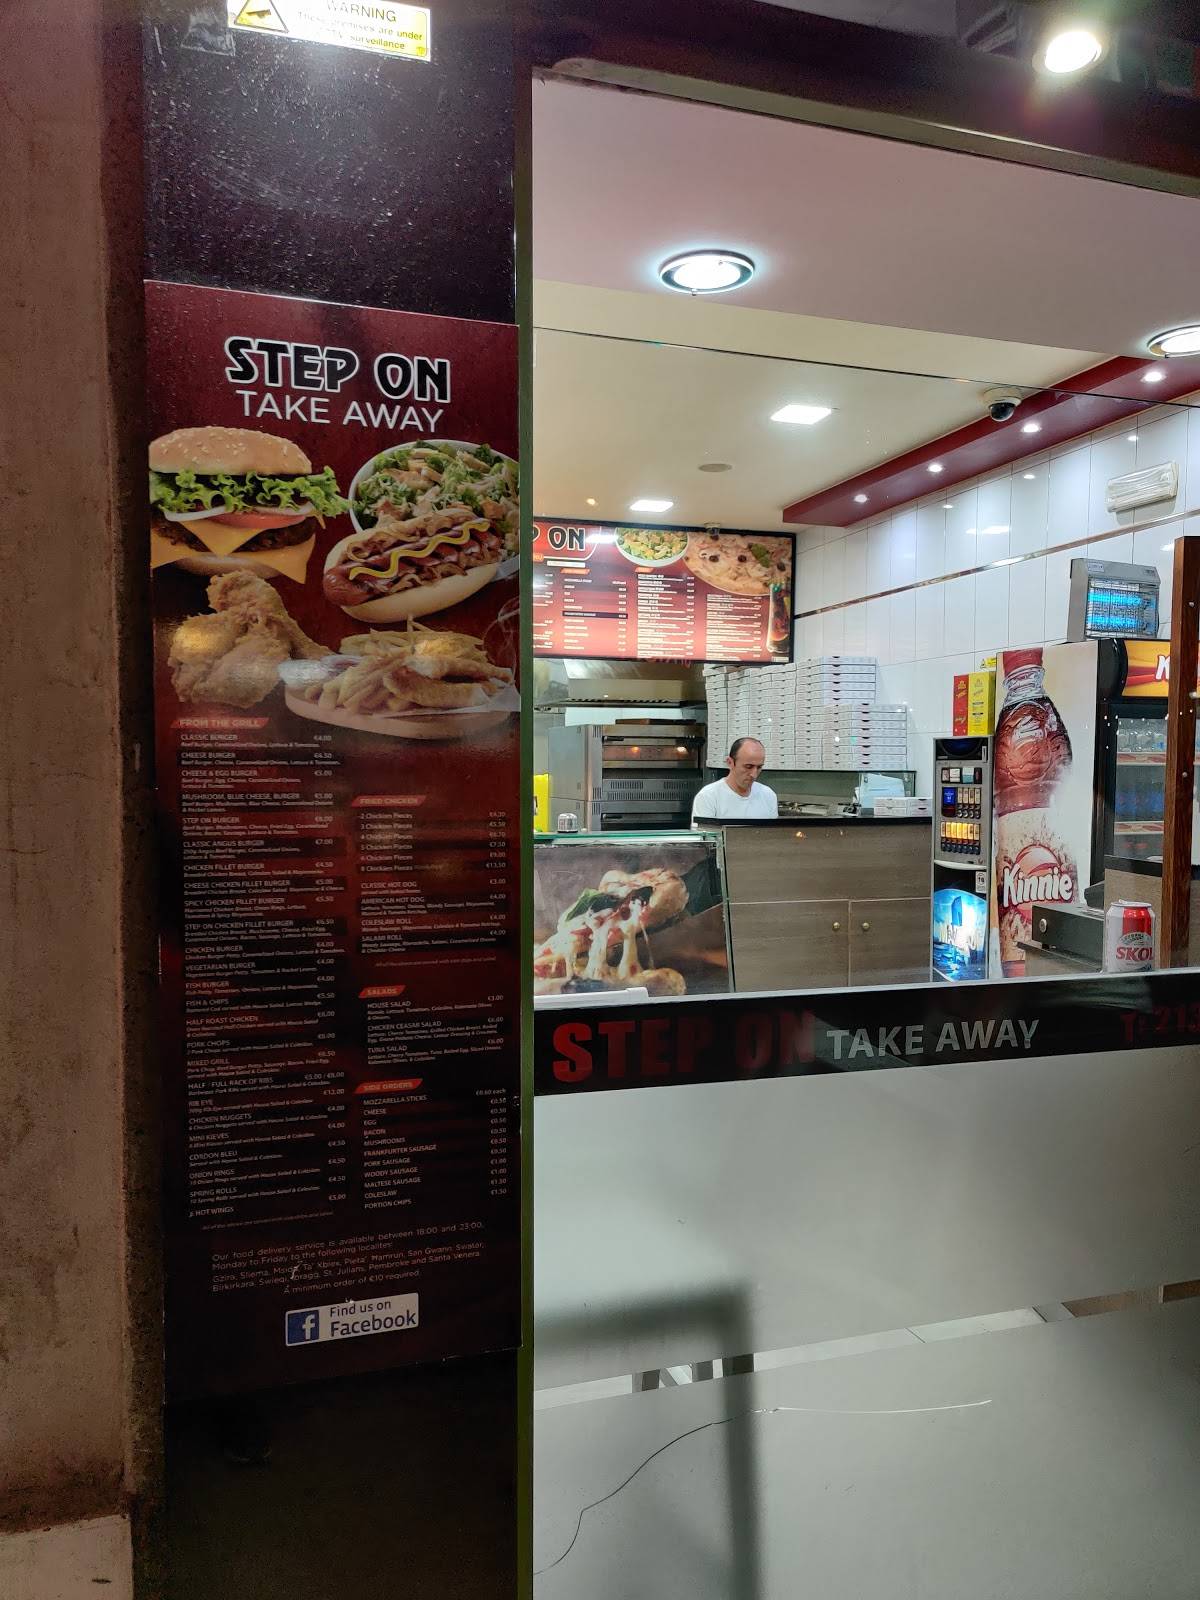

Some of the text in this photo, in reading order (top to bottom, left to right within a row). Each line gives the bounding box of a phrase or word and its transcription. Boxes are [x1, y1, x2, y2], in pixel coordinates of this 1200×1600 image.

[326, 0, 397, 22] WARNING
[397, 30, 422, 41] under
[350, 35, 405, 50] surveillance
[224, 336, 450, 403] STEP ON
[235, 389, 444, 433] TAKE AWAY
[548, 525, 586, 551] ON
[264, 879, 290, 887] BURGER
[1003, 863, 1073, 908] Kinnie
[209, 998, 229, 1006] CHIPS
[186, 1018, 203, 1026] HALF
[229, 1015, 259, 1023] CHICKEN
[367, 1024, 394, 1032] CHICKEN
[552, 1016, 713, 1083] STEP
[735, 1009, 816, 1070] ON
[826, 1024, 924, 1060] TAKE
[936, 1019, 1040, 1053] AWAY
[188, 1081, 205, 1089] HALF
[211, 1080, 229, 1088] FULL
[363, 1097, 406, 1105] MOZZARELLA
[188, 1113, 252, 1125] CHICKEN NUGGETS
[188, 1150, 238, 1161] CORDON BLEU
[363, 1144, 437, 1156] FRANKFURTER SAUSAGE
[382, 1157, 410, 1166] SAUSAGE
[188, 1168, 235, 1179] ONION RINGS
[363, 1167, 418, 1178] WOODY SAUSAGE
[363, 1177, 421, 1188] MALTESE SAUSAGE
[189, 1187, 237, 1198] SPRING ROLLS
[364, 1190, 397, 1199] COLESLAW
[364, 1198, 412, 1209] PORTION CHIPS
[211, 1206, 234, 1215] WINGS
[212, 1254, 229, 1262] Our
[233, 1249, 254, 1259] food
[257, 1247, 291, 1257] delivery
[295, 1241, 325, 1251] service
[338, 1234, 375, 1246] available
[378, 1230, 413, 1241] between
[441, 1224, 456, 1232] and
[212, 1261, 248, 1271] Monday
[261, 1255, 288, 1265] Friday
[302, 1250, 316, 1259] the
[318, 1244, 356, 1258] following
[369, 1259, 409, 1270] Pembroke
[410, 1257, 427, 1265] and
[428, 1253, 451, 1263] Santa
[292, 1273, 384, 1293] minimum order of €10
[330, 1301, 391, 1317] Find us on
[302, 1310, 416, 1340] f Facebook
